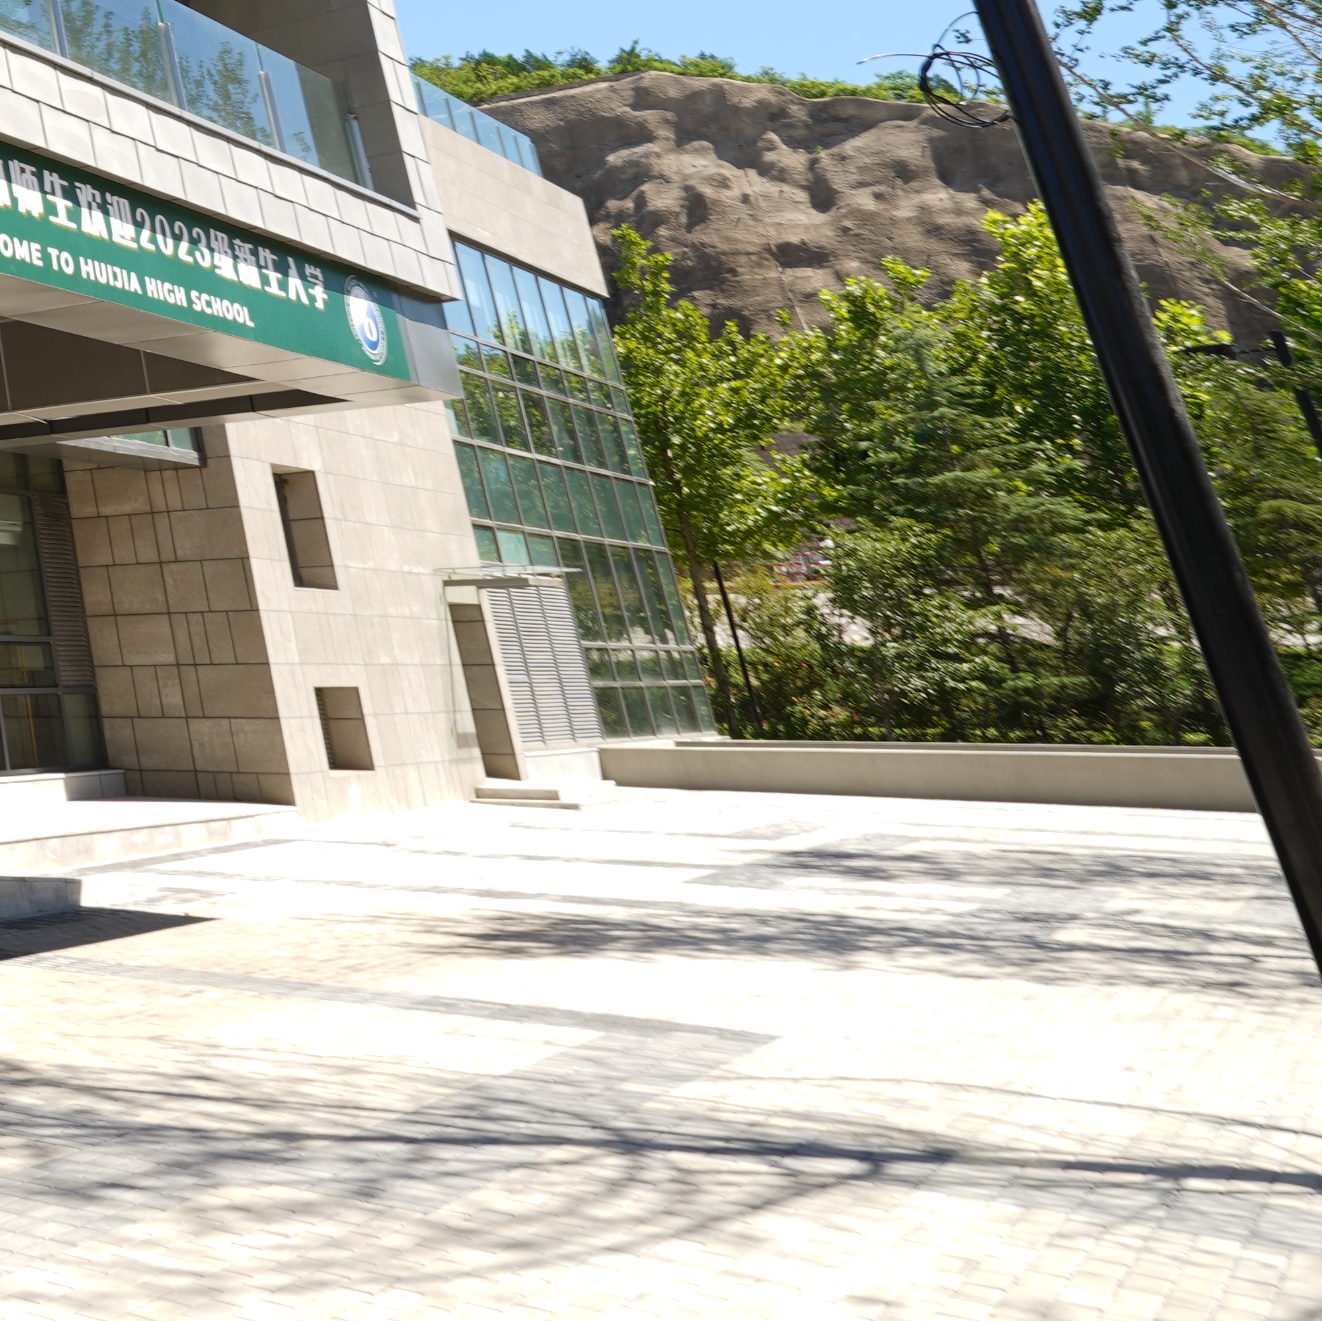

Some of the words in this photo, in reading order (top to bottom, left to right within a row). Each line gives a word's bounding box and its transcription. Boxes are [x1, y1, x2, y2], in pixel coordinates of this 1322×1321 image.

[47, 246, 75, 275] TO
[78, 256, 143, 296] HUIJIA
[145, 275, 189, 309] HIGH
[190, 289, 255, 329] SCHOOL
